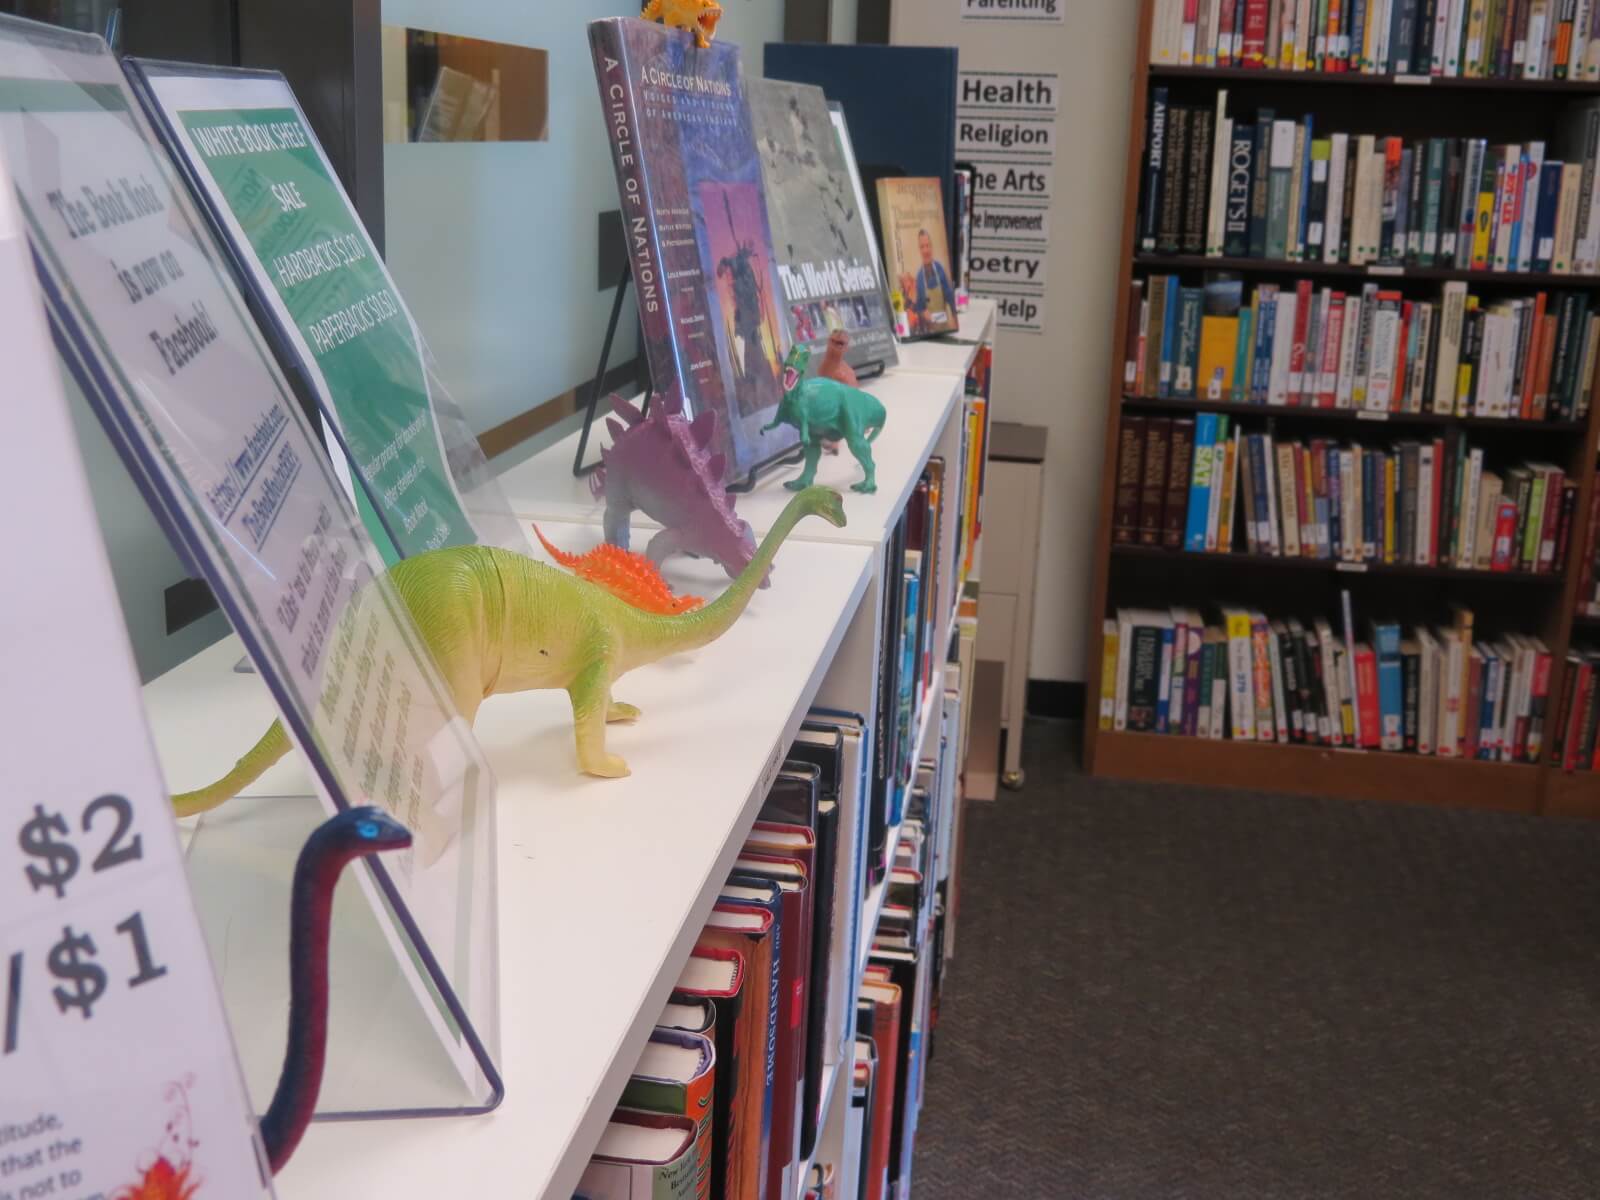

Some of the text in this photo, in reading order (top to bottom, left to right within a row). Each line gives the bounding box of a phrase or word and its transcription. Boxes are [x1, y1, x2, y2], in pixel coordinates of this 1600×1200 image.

[641, 66, 732, 97] A CIRCLE OF NATIONS
[961, 79, 1052, 104] Health
[191, 121, 307, 158] WHITE BOOK SHELF
[959, 123, 1049, 147] Religion
[1151, 102, 1166, 170] AIRPORT
[271, 181, 307, 212] SALE
[604, 56, 658, 314] A CIRCLE OF NATIONS
[974, 167, 1046, 192] he Arts
[47, 177, 165, 240] The Book Nook
[984, 210, 1043, 233] Improvement
[110, 250, 186, 304] is now on
[273, 233, 366, 288] HARDBACKS $1.00
[777, 258, 876, 301] The World Series
[970, 255, 1040, 279] oetry
[308, 289, 398, 355] PAPERBACKS $0.50
[998, 299, 1037, 322] Help
[149, 300, 220, 376] Facebook!
[19, 794, 143, 899] $2
[766, 957, 780, 1087] HANDSOME
[1, 1137, 82, 1178] that the
[20, 1175, 56, 1200] not
[60, 1168, 83, 1191] to
